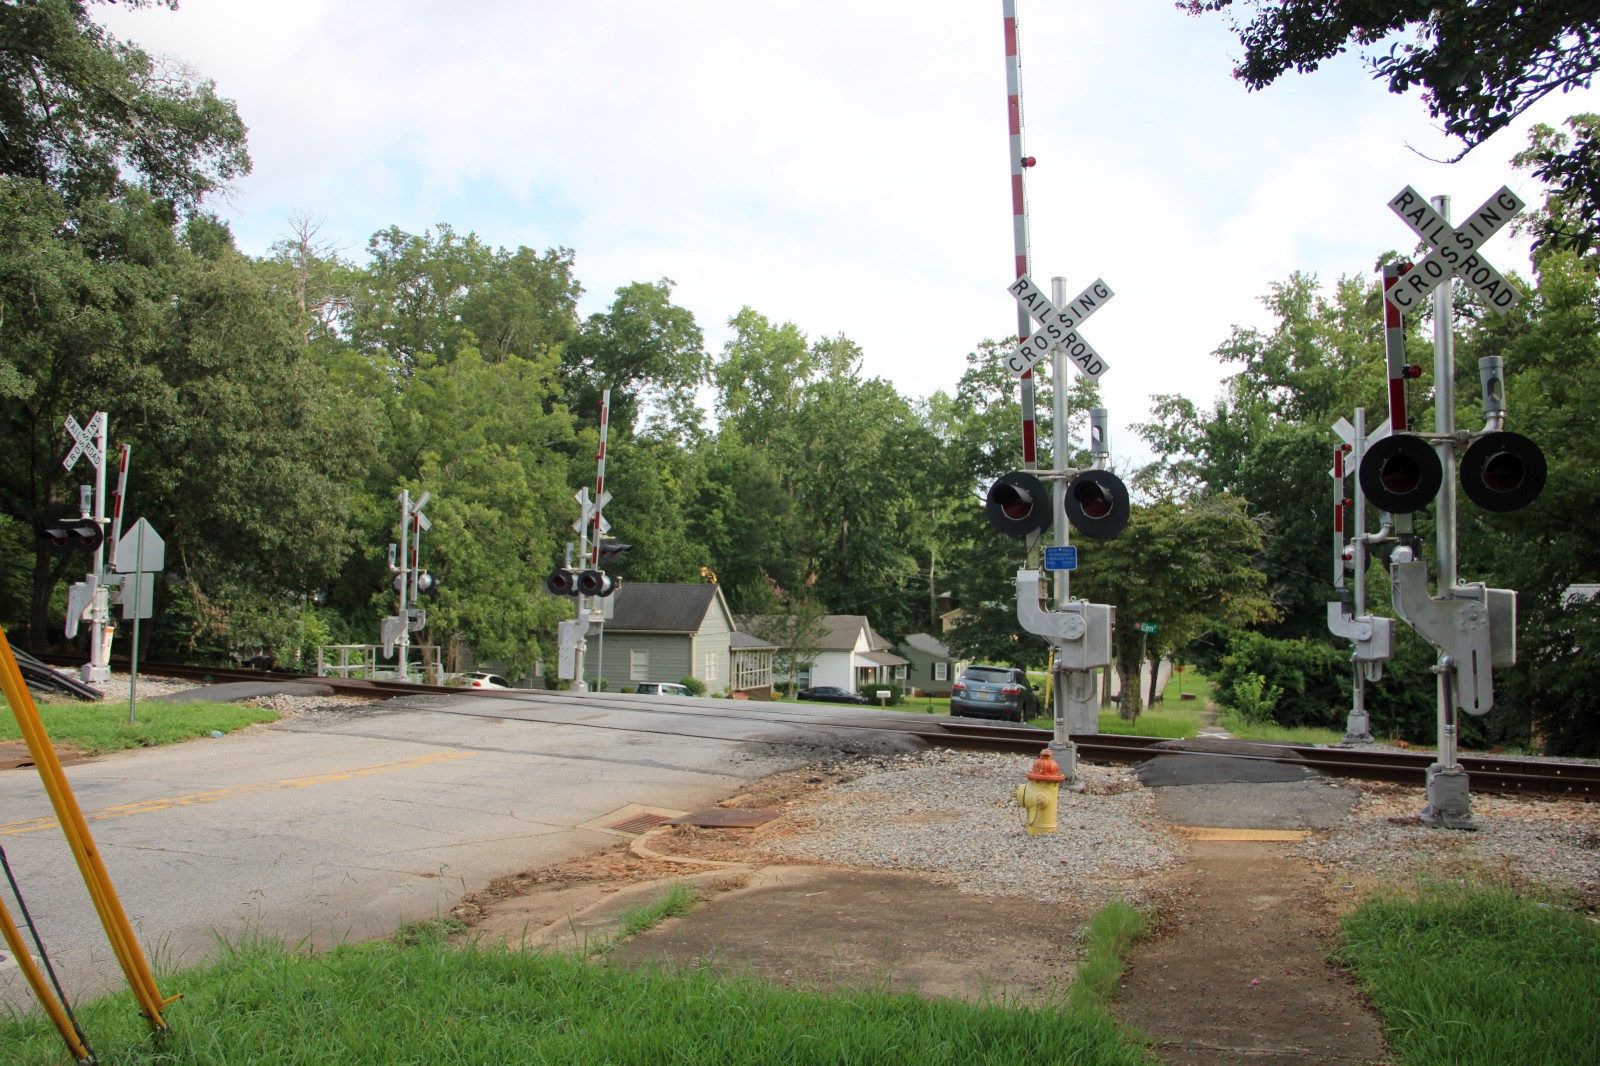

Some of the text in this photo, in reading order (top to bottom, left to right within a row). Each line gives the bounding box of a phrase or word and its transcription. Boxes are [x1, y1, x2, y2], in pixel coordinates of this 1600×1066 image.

[1394, 191, 1513, 307] RAIL ROAD
[1394, 193, 1516, 306] CROSSING
[1009, 284, 1108, 372] CROSSING
[1013, 279, 1102, 375] RAIL ROAD
[65, 415, 101, 467] CROSSING
[66, 418, 101, 464] RAIL ROAD
[1140, 622, 1154, 632] Elm
